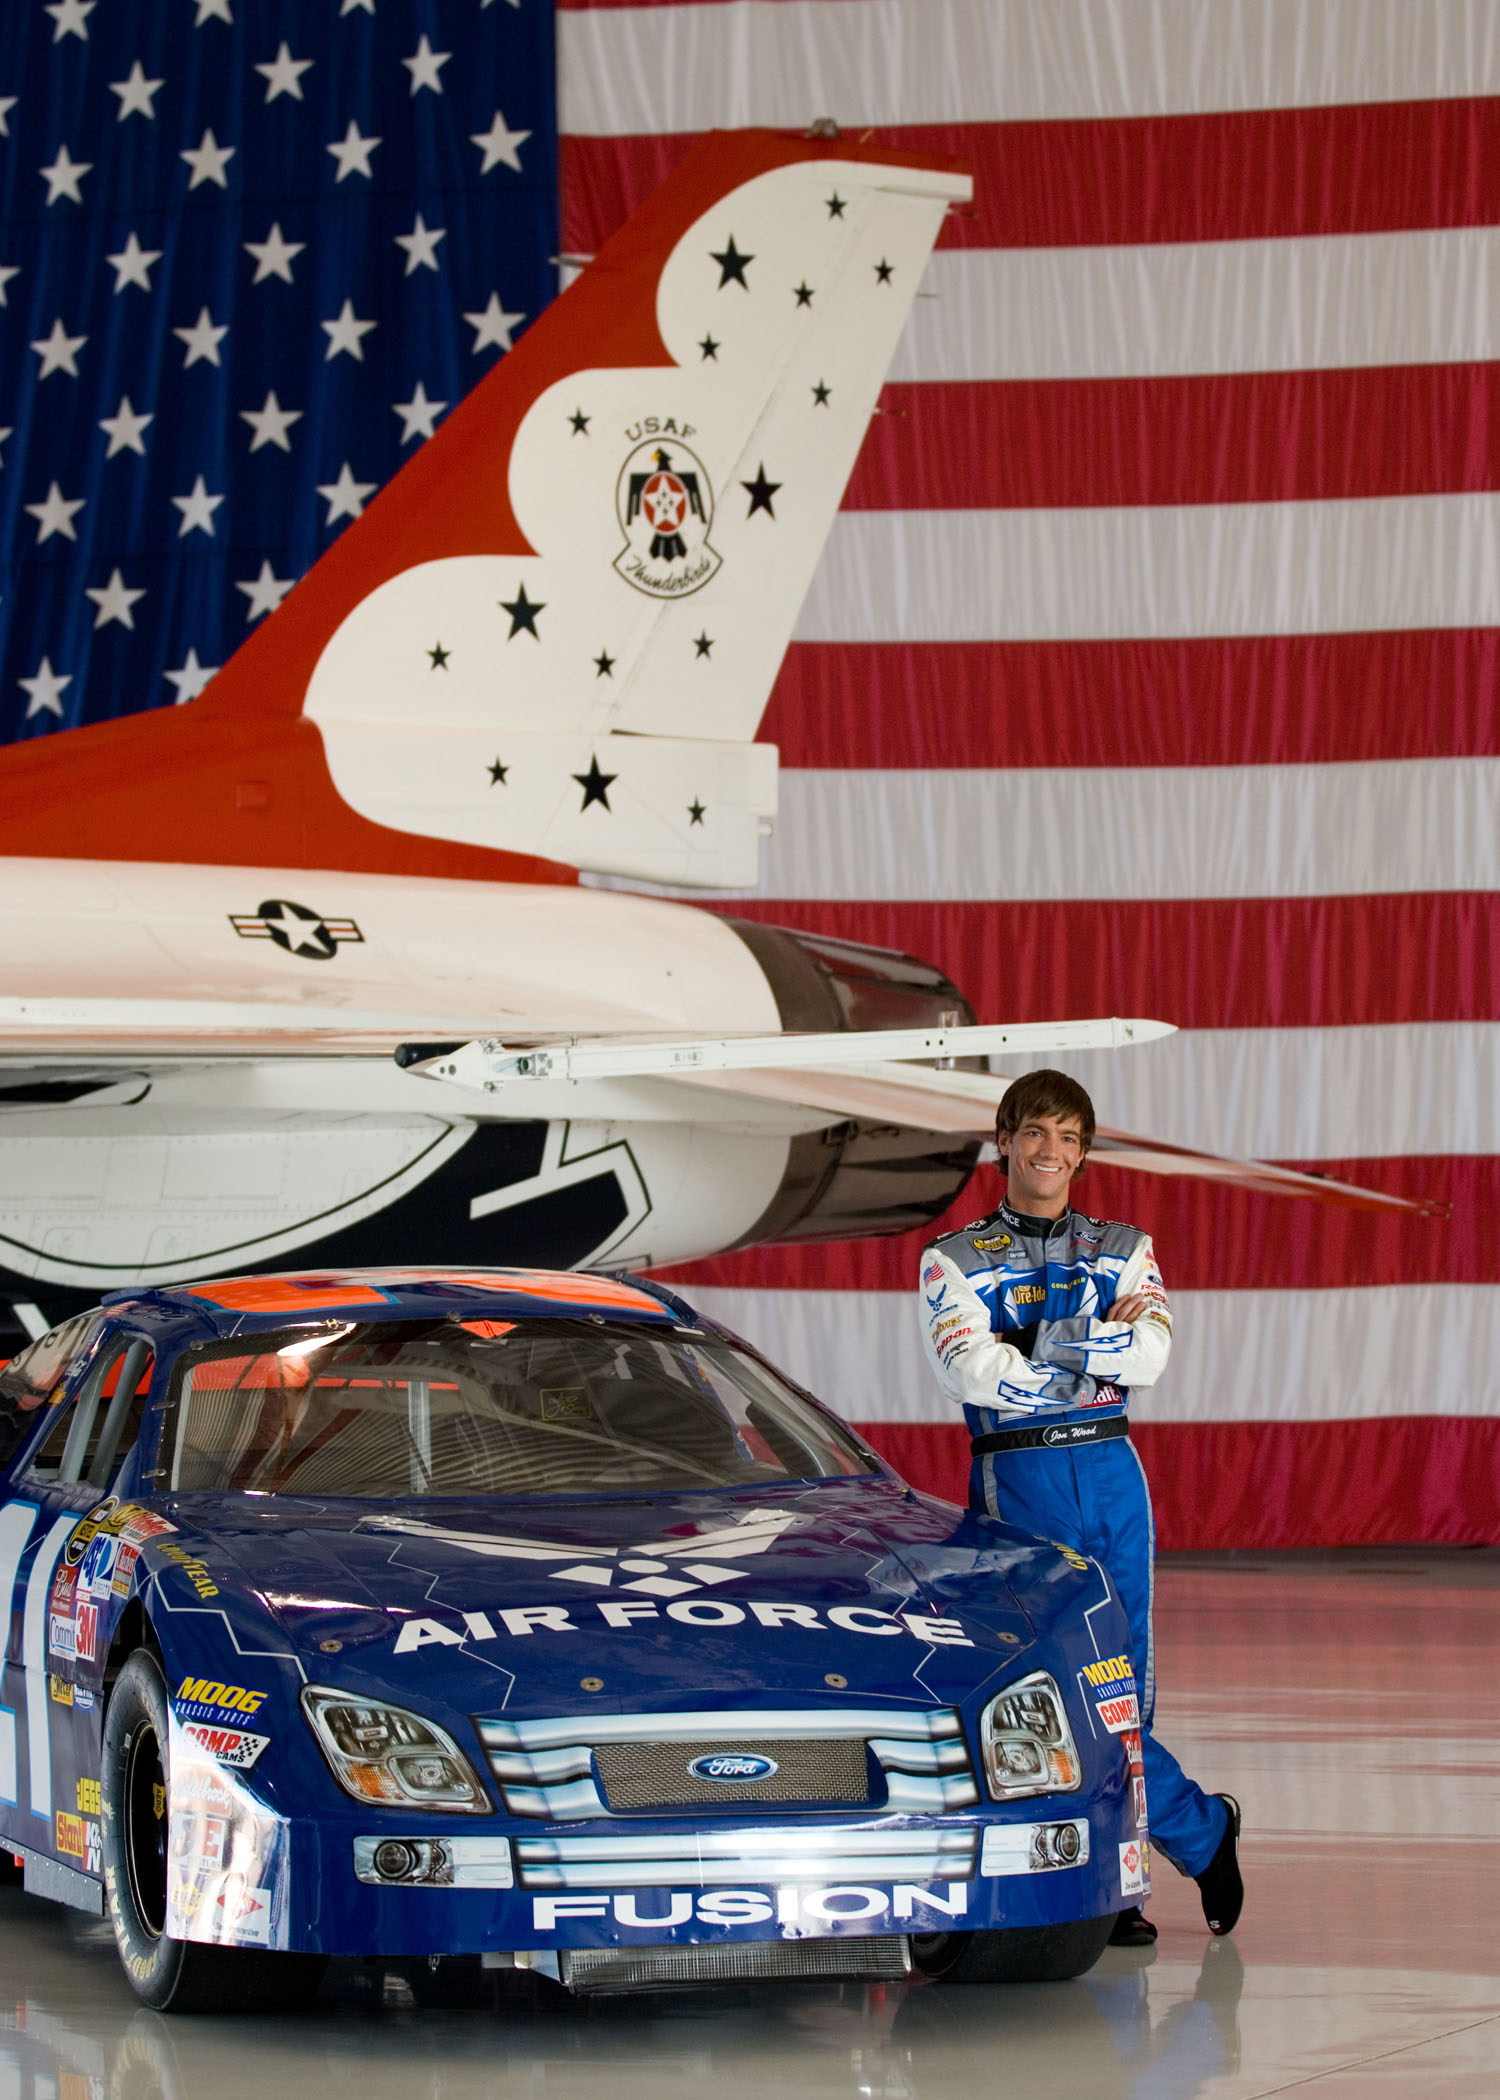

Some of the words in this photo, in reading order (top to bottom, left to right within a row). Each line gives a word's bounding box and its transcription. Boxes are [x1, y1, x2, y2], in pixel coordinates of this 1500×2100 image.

[624, 417, 697, 442] USAF
[625, 555, 711, 592] Thunderbirds
[1013, 1286, 1046, 1304] Ore-Ida
[1051, 1277, 1087, 1291] GOODYEAR
[1049, 1430, 1068, 1443] Jon
[1071, 1425, 1097, 1438] Wood
[156, 1543, 219, 1599] GOODYEAR
[76, 1604, 97, 1658] 3M
[393, 1606, 580, 1654] AIR
[596, 1600, 976, 1648] FORCE
[1082, 1654, 1133, 1688] MOOG
[176, 1676, 268, 1714] MOOG
[176, 1702, 214, 1719] CHASSIS
[217, 1709, 251, 1726] PARTS
[1100, 1698, 1134, 1726] COMP
[215, 1751, 246, 1763] CAMS
[709, 1757, 757, 1776] Ford
[533, 1882, 967, 1931] FUSION
